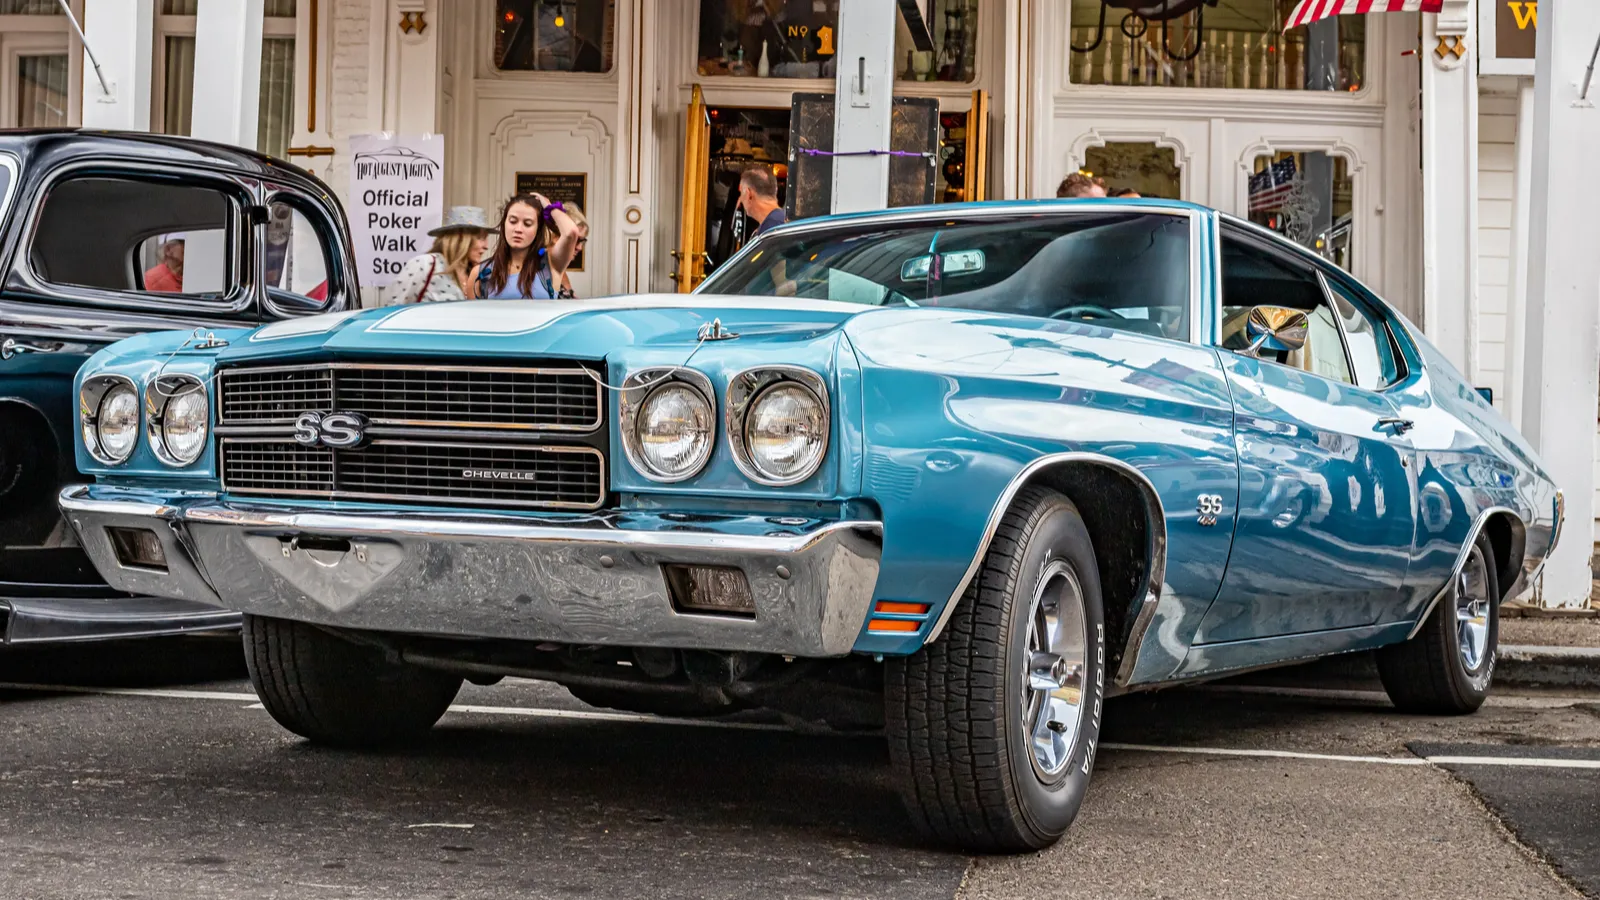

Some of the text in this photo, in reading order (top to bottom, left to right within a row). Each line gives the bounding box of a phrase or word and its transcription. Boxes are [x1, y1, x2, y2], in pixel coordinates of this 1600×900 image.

[357, 162, 434, 180] HOT AUGUST NIGHTS
[363, 189, 429, 207] Official
[368, 212, 421, 229] Poker
[372, 235, 417, 252] Walk
[373, 257, 407, 274] Sto
[294, 412, 363, 446] SS
[462, 470, 534, 480] CHEVELLE
[1197, 493, 1223, 515] SS
[1091, 624, 1104, 729] Radial
